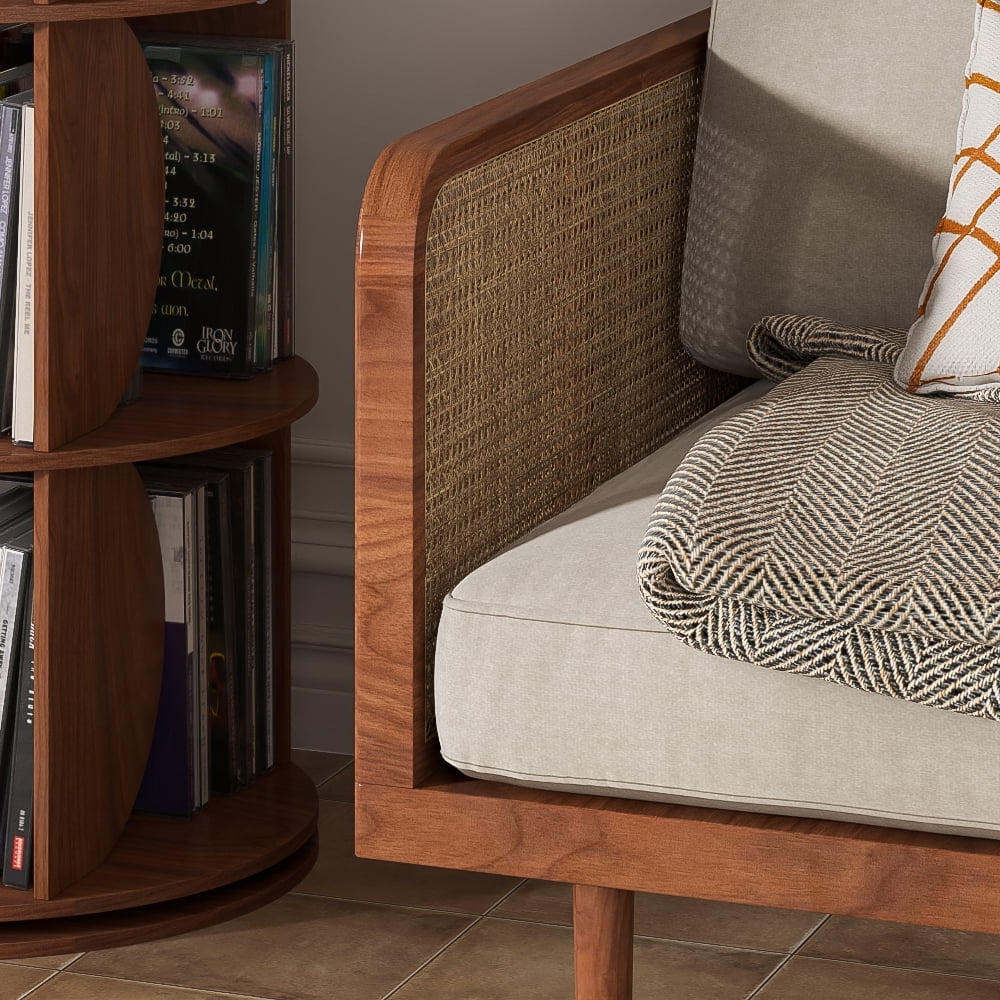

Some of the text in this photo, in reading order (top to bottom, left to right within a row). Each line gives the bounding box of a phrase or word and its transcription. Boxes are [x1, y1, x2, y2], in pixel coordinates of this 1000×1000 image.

[192, 152, 215, 162] 3:13
[2, 156, 13, 189] JENNIFER
[0, 191, 9, 214] LOPEZ
[172, 197, 195, 208] 3:32
[191, 229, 213, 239] 1:04
[167, 243, 191, 253] 6:00
[24, 323, 30, 335] ME
[202, 325, 232, 340] IRON
[196, 338, 237, 355] GLORY
[0, 619, 8, 648] GETTING
